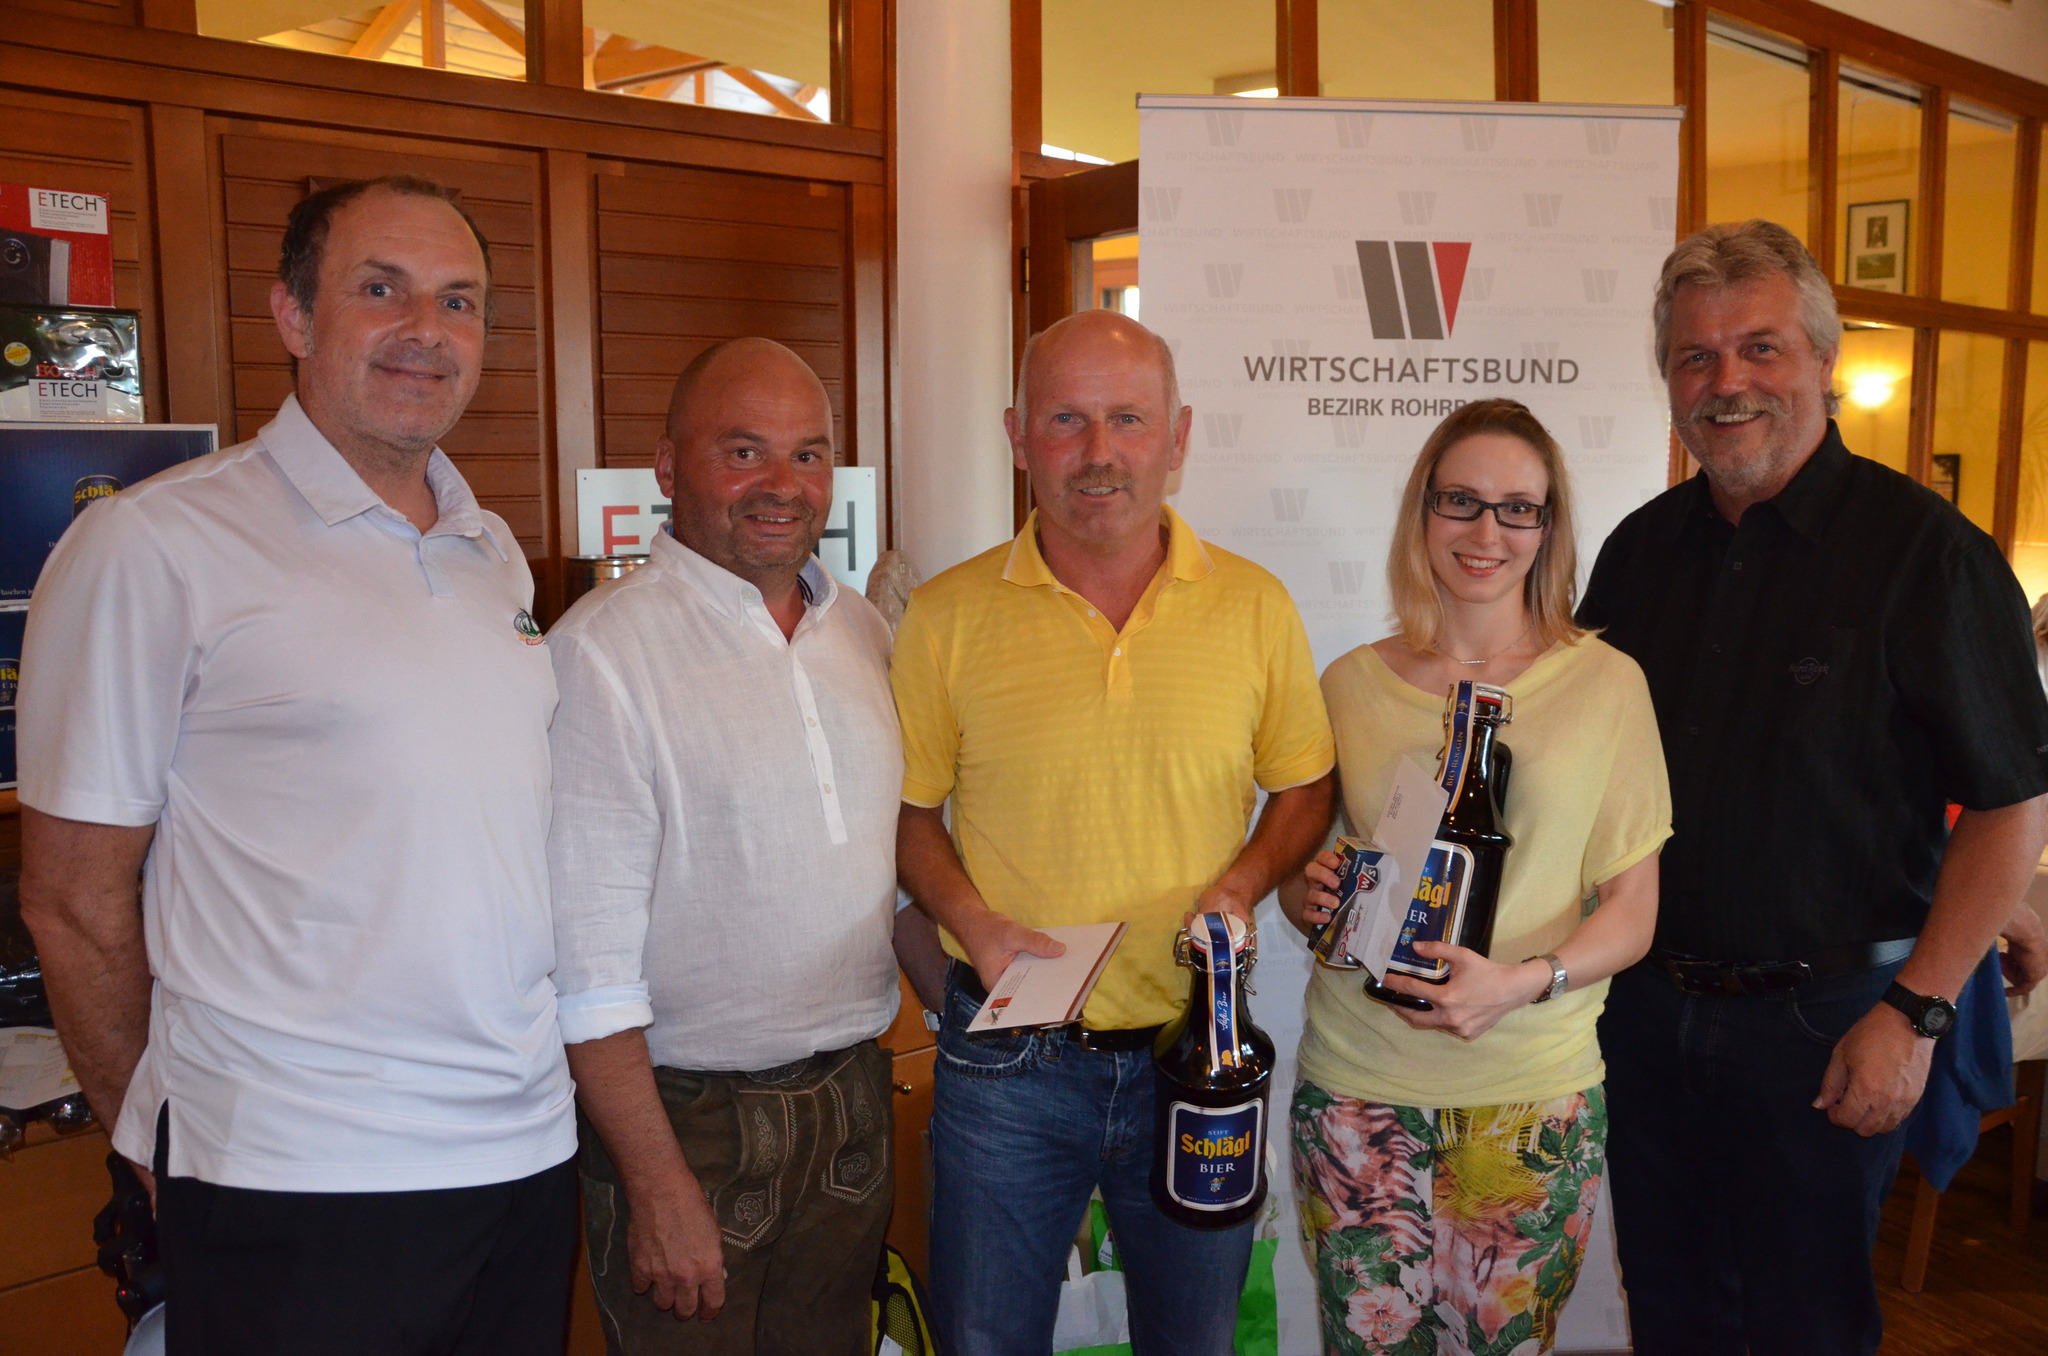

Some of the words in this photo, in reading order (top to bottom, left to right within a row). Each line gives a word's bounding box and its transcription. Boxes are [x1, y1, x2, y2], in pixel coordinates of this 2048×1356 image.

[38, 192, 97, 211] ETECH
[36, 364, 98, 378] BOH
[1243, 356, 1580, 384] WIRTSCHAFTSBUND
[38, 382, 98, 397] ETECH
[1308, 398, 1384, 416] BEZIRK
[1446, 770, 1455, 786] BIO
[1451, 731, 1464, 768] ROGGEN
[1404, 909, 1429, 925] ER
[1337, 908, 1357, 958] DX3
[1181, 1130, 1251, 1160] Schlägl
[1200, 1163, 1236, 1173] BIER
